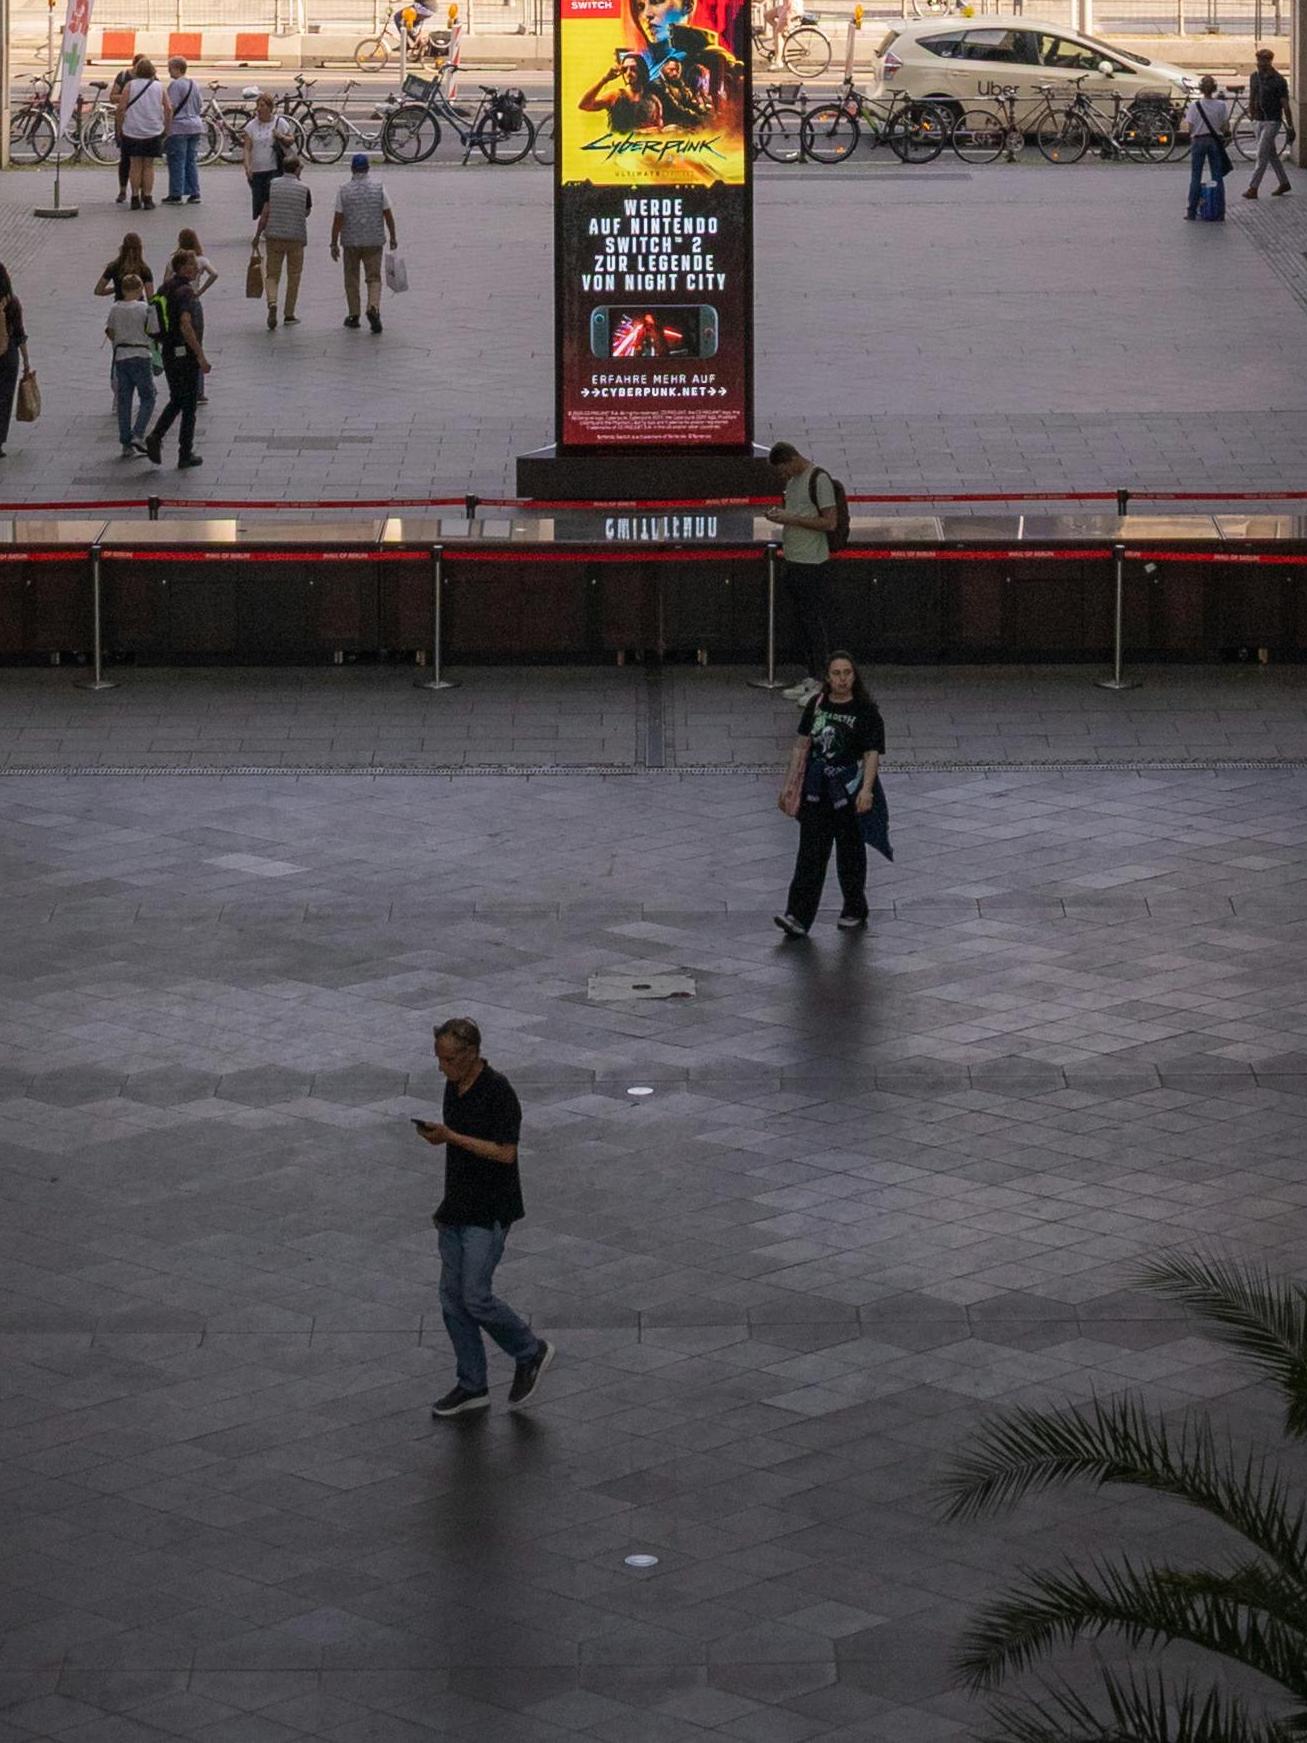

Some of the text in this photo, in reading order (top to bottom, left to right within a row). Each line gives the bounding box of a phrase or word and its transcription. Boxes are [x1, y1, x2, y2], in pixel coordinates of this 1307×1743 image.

[571, 2, 613, 10] SWITCH
[977, 80, 1020, 96] Uber
[624, 199, 683, 216] WERDE
[589, 217, 718, 235] AUF NINTENDO
[692, 236, 702, 253] 2
[594, 255, 714, 272] ZUR LEGENDE
[582, 274, 726, 291] VON NIGHT CITY
[592, 374, 716, 385] ERFAHRE MEHR AUF
